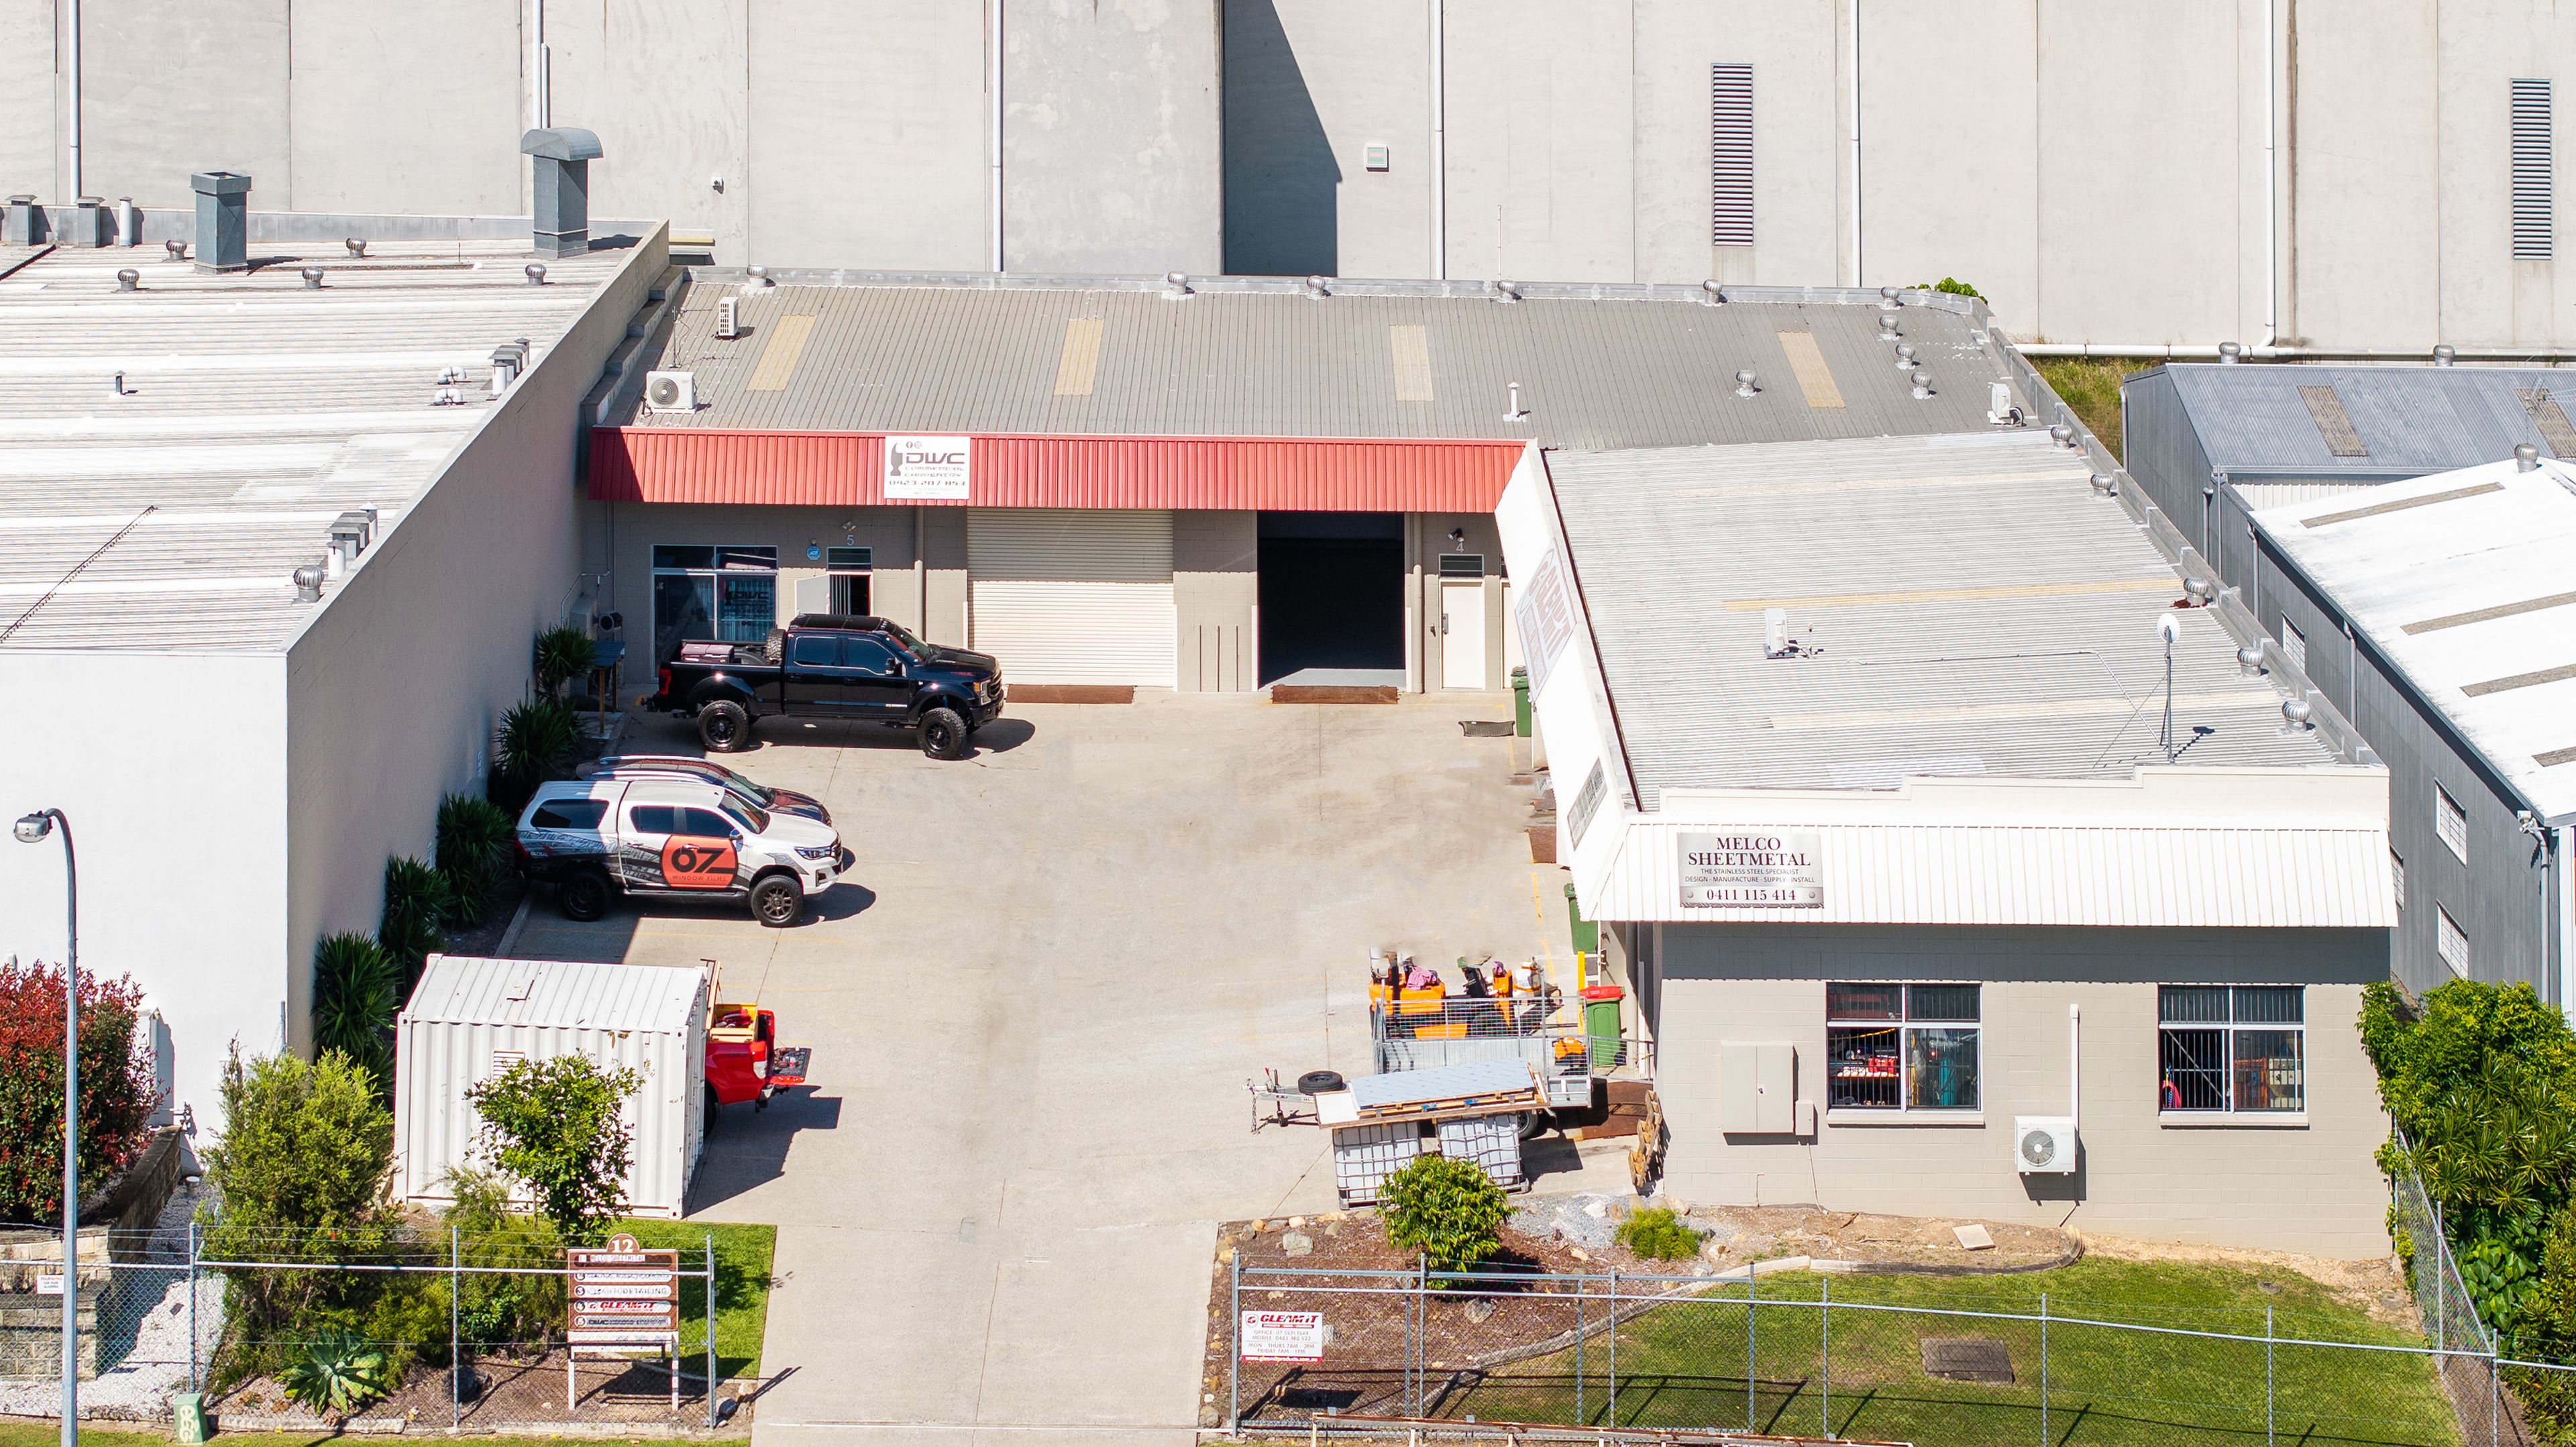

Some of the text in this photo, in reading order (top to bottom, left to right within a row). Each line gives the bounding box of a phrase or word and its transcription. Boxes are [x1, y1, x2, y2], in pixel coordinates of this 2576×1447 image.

[906, 453, 965, 464] DWC
[847, 534, 855, 546] 5
[1456, 542, 1464, 553] 4
[1716, 837, 1781, 851] MELCO
[672, 847, 736, 873] OZ
[1688, 852, 1811, 866] SHEETMETAL
[1707, 889, 1796, 901] 0411 115 414
[611, 1239, 634, 1252] 12
